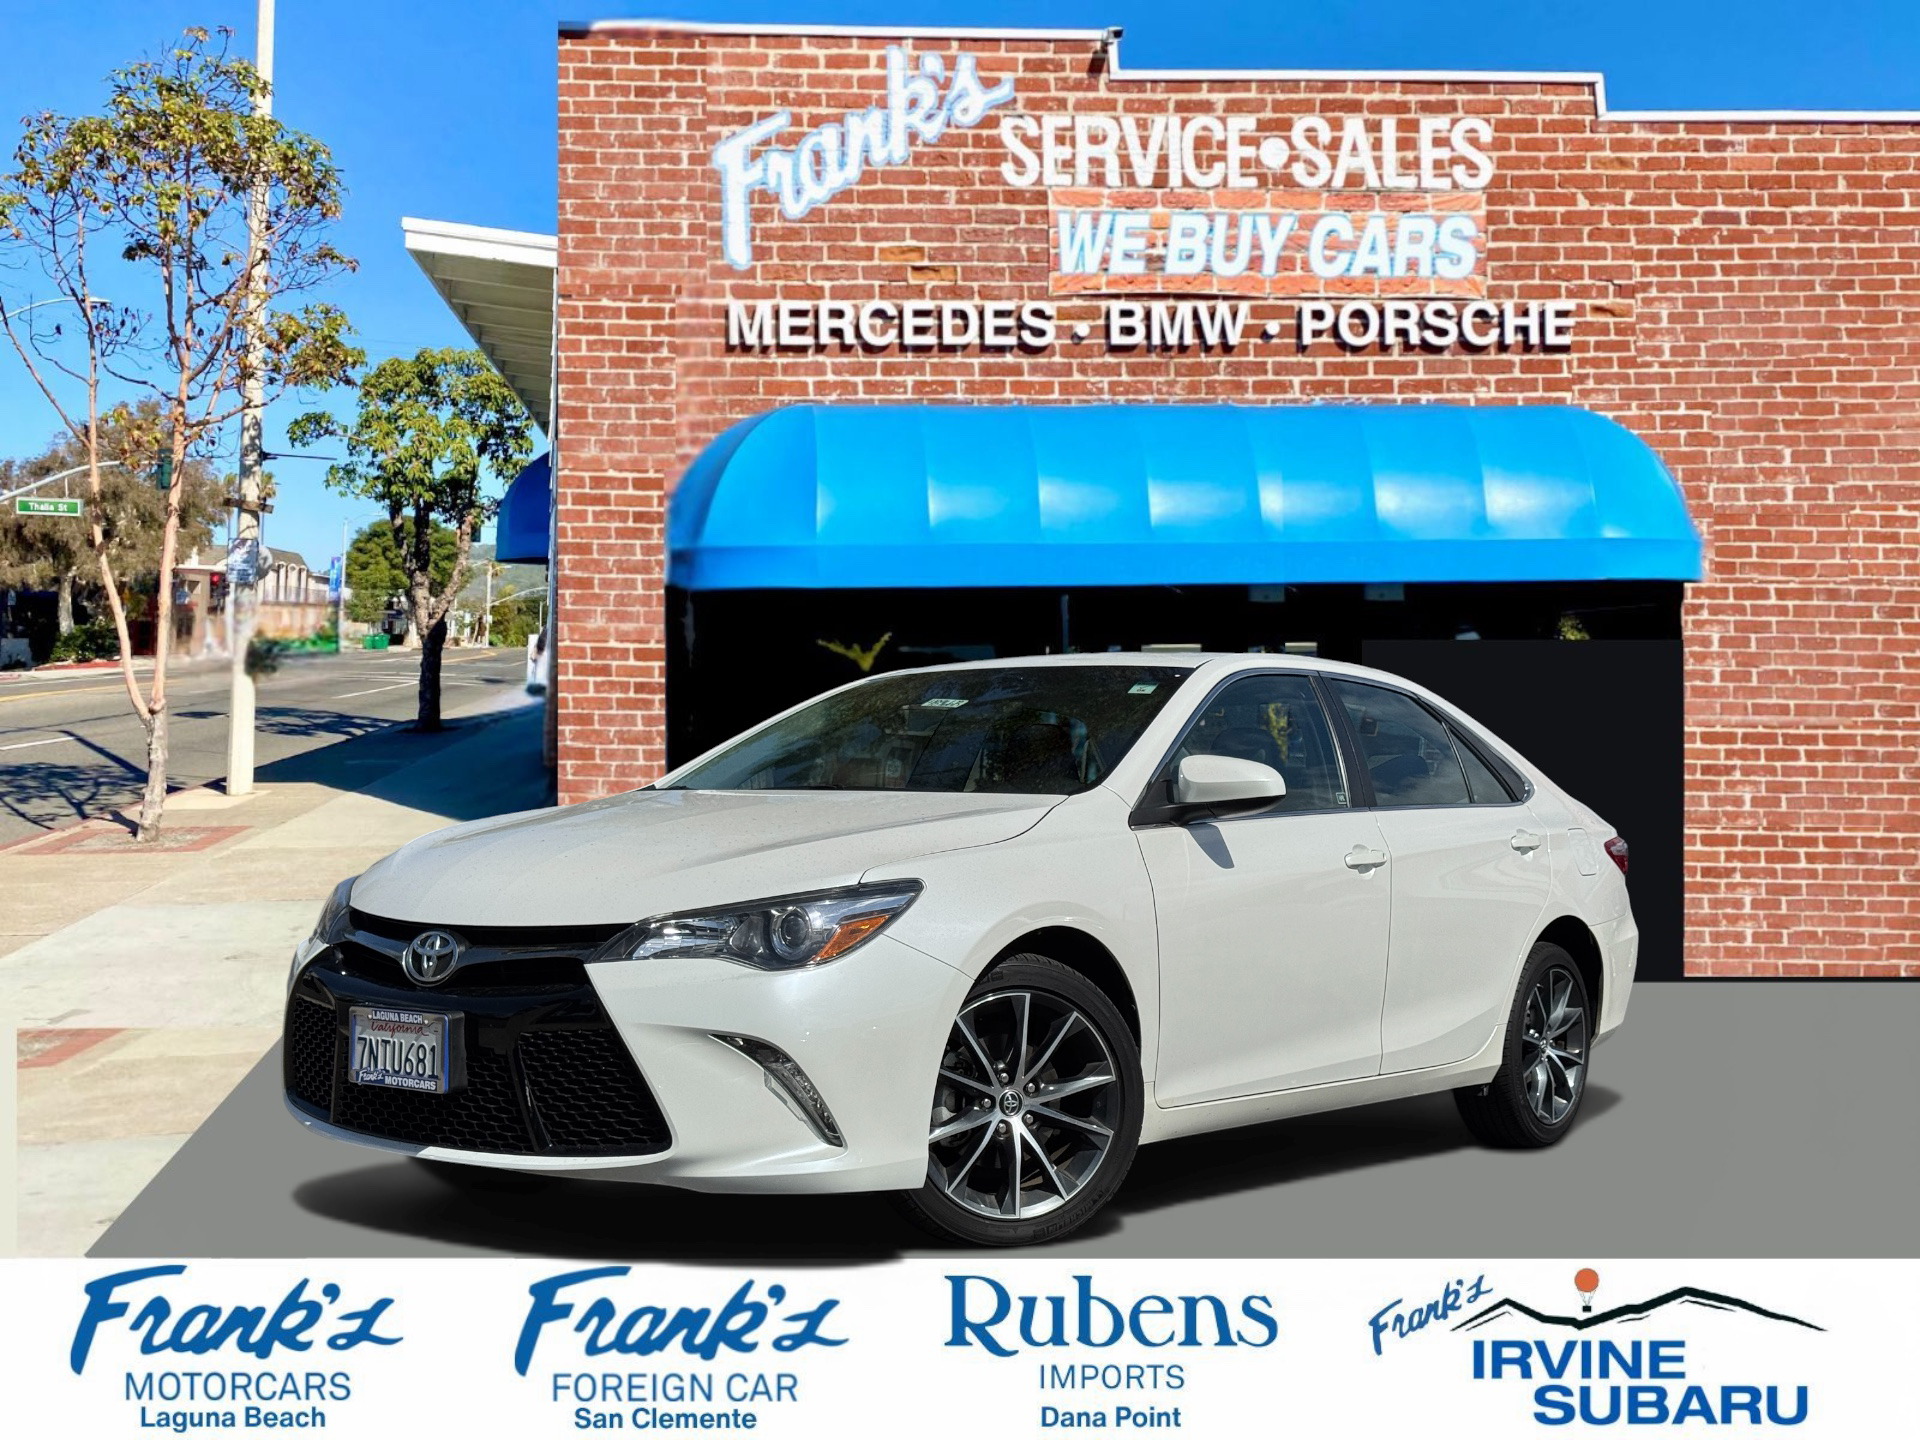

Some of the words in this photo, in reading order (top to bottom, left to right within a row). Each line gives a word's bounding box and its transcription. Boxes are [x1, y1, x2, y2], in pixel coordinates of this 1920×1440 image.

[712, 44, 1015, 271] Frank's
[1000, 114, 1259, 188] SERVICE
[1290, 115, 1494, 189] SALES
[1056, 210, 1151, 276] WE
[1163, 211, 1298, 278] BUY
[1308, 212, 1479, 280] CARS
[726, 299, 1057, 350] MERCEDES
[1106, 300, 1249, 349] BMW
[1299, 300, 1577, 349] PORSCHE
[28, 502, 55, 511] Thalia
[57, 503, 68, 512] St
[371, 1021, 429, 1038] California
[372, 1010, 400, 1022] LAGUNA
[400, 1013, 423, 1024] BEACH
[384, 1076, 436, 1090] MOTORCARS
